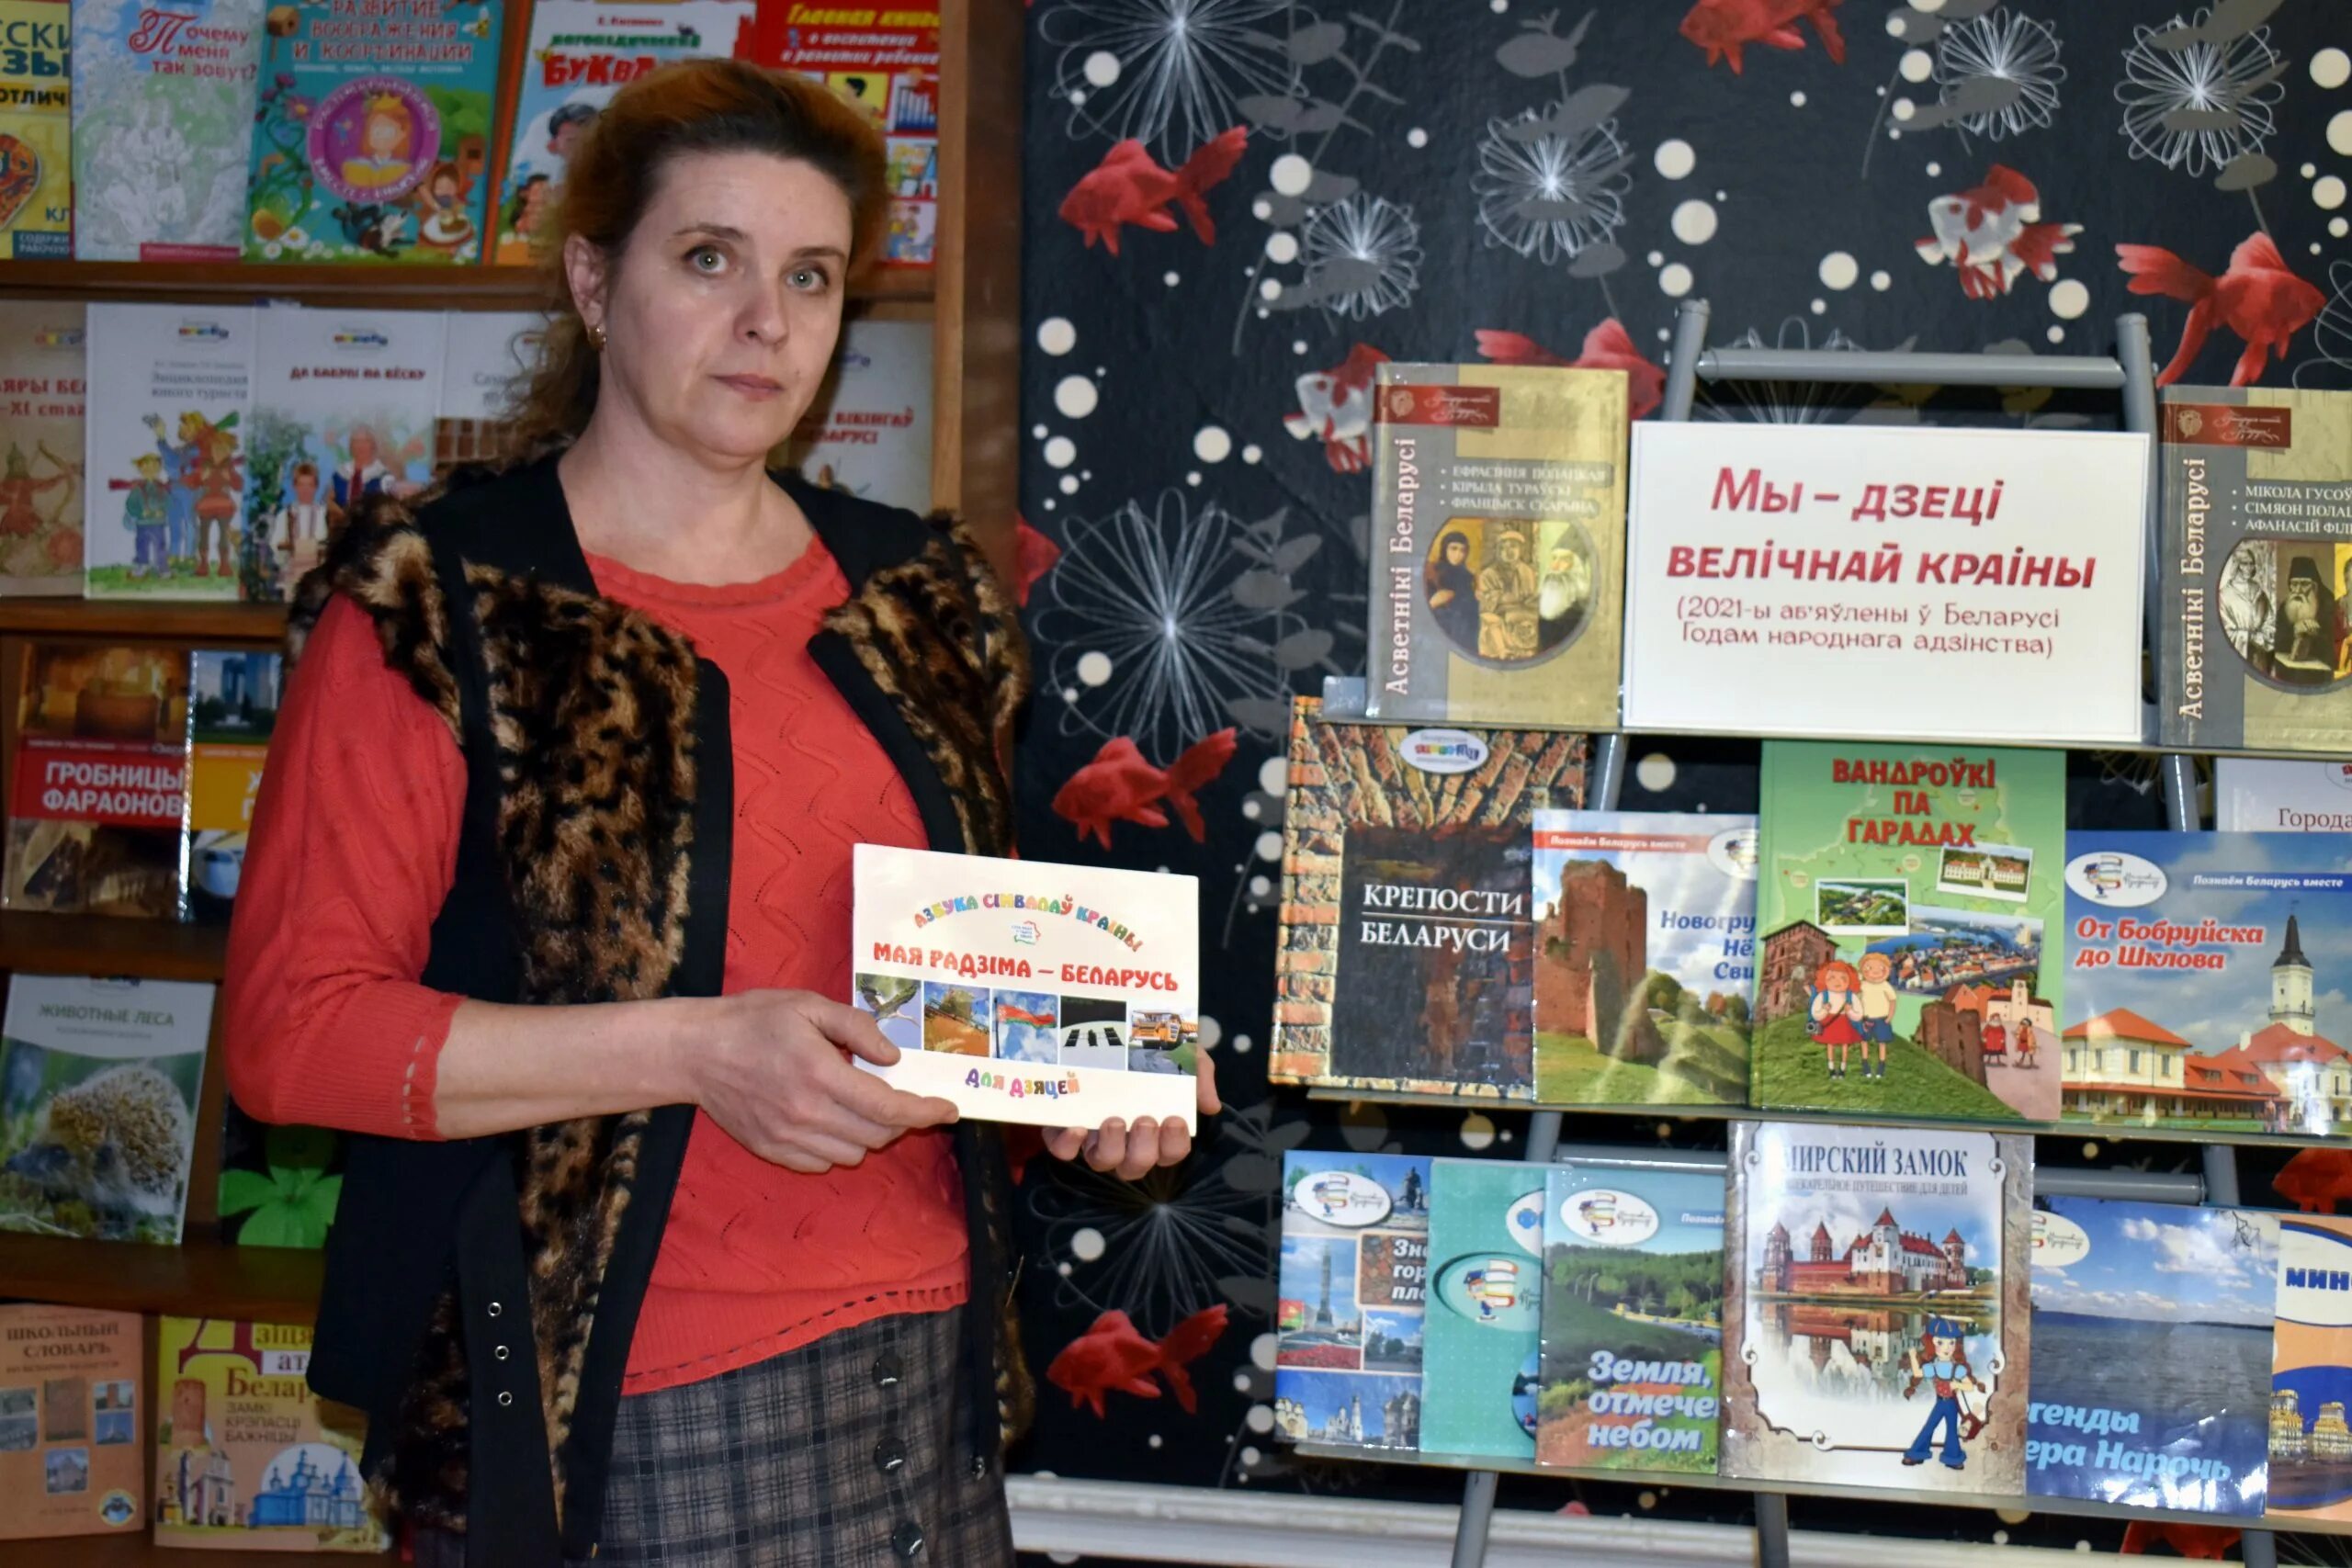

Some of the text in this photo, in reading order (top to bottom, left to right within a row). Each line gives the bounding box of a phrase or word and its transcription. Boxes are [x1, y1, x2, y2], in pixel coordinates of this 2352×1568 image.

[178, 44, 230, 59] меня
[153, 61, 186, 73] так
[0, 378, 86, 395] ЯРЫ БЕ
[1712, 468, 1803, 513] Мы
[2245, 485, 2352, 501] МІКОЛА ГУСОЎ
[2245, 502, 2302, 516] СІМЯОН
[2245, 518, 2320, 534] АФАНАСІЙ
[1386, 438, 1419, 694] Асветнікі Беларусі
[2179, 458, 2211, 719] Асветнікі Беларусі
[1919, 606, 1932, 626] ў
[1945, 603, 2060, 628] Беларусі
[1682, 621, 2054, 660] Годам народнага адзінства)
[46, 761, 184, 792] ГРОБНИЦЫ
[1832, 757, 1996, 789] ВАНДРОЎКІ
[42, 788, 183, 818] ФАРАОНОВ
[1894, 790, 1931, 816] ПА
[1848, 818, 1977, 848] ГАРАДАХ
[2278, 807, 2352, 832] Города
[2193, 874, 2344, 889] Познаём Беларусь вместе
[1363, 884, 1523, 917] КРЕПОСТИ
[913, 893, 1144, 953] АЗБУКА СІМВАЛАЎ КРАІНЫ
[1360, 920, 1510, 954] БЕЛАРУСИ
[2076, 917, 2264, 947] От Бобруйска
[1723, 938, 1756, 957] Нё
[2075, 946, 2225, 970] до Шклова
[874, 942, 922, 966] МАЯ
[930, 949, 1032, 979] РАДЗІМА
[1060, 963, 1179, 992] БЕЛАРУСЬ
[40, 1003, 175, 1027] ЖИВОТНЫЕ ЛЕСА
[965, 1067, 1080, 1099] ДЛЯ ДЗЯЦЕЙ
[1893, 1147, 1969, 1178] ЗАМОК
[1681, 1213, 1724, 1224] Познаё
[2286, 1267, 2352, 1292] МИН
[23, 1342, 111, 1358] СЛОВАРЬ
[1588, 1350, 1713, 1388] Земля,
[2027, 1402, 2140, 1436] генды
[1588, 1419, 1702, 1450] небом
[2095, 1439, 2231, 1482] Нарочь
